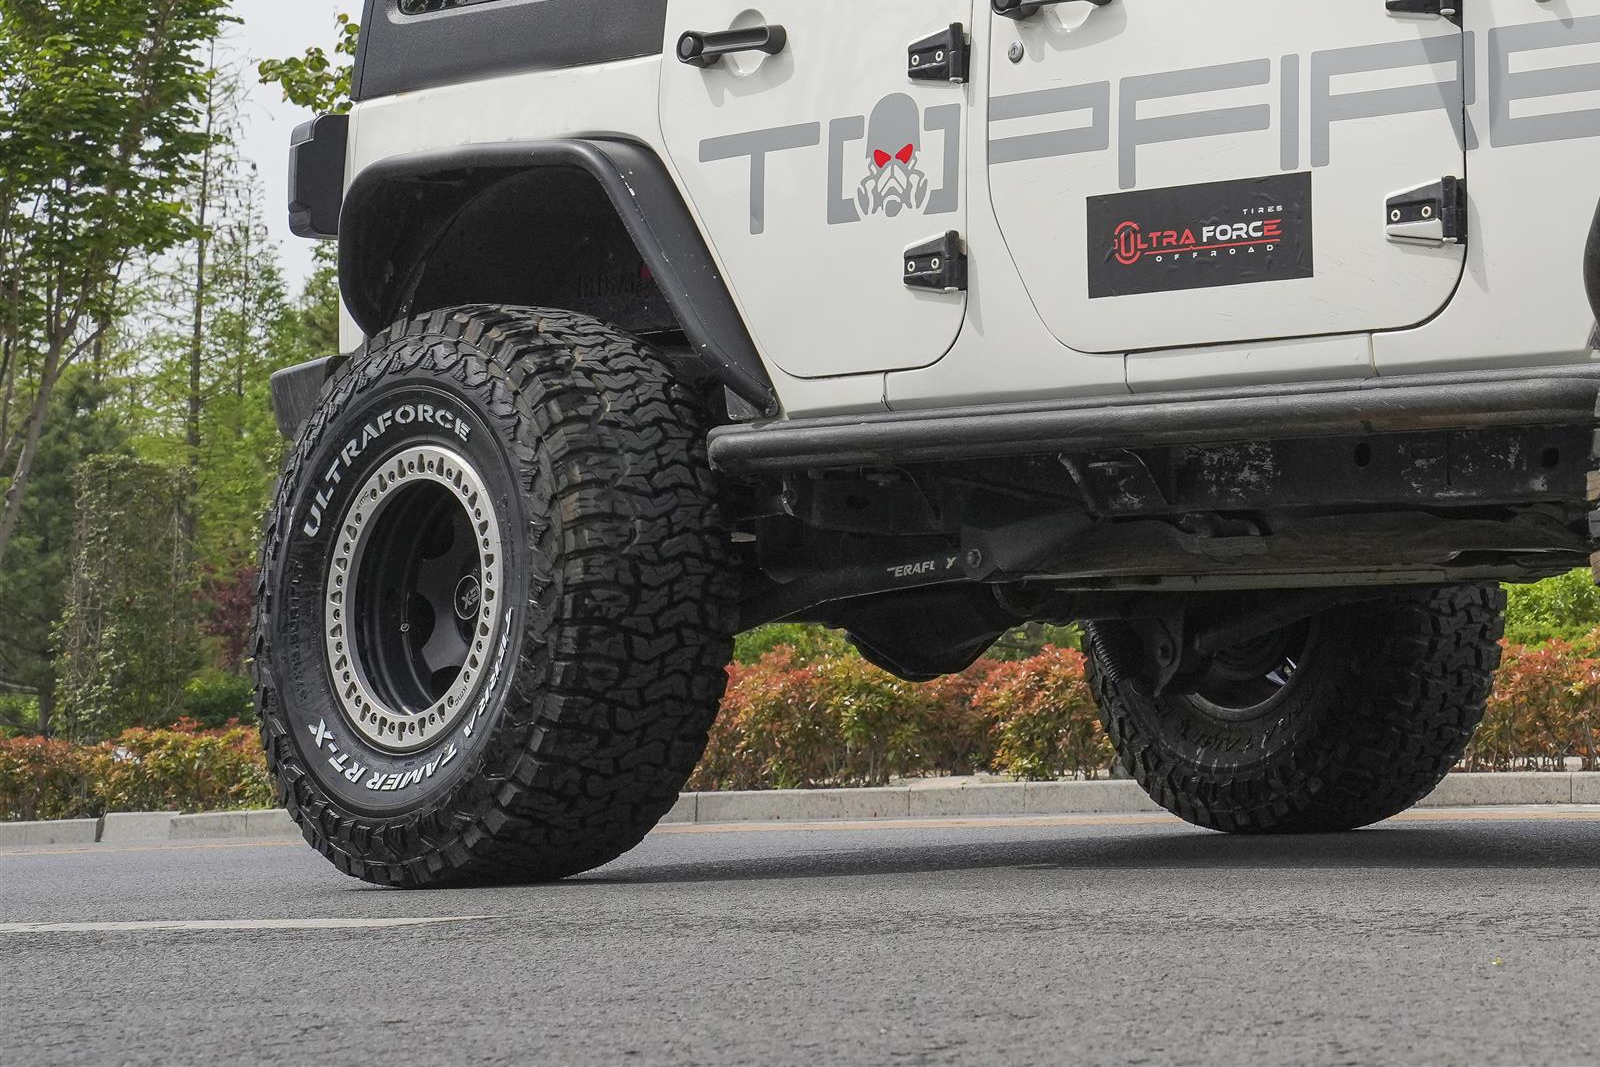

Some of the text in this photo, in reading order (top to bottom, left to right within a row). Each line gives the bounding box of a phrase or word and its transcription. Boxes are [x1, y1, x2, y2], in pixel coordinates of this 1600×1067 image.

[1242, 205, 1283, 215] TIRES
[1114, 219, 1282, 265] ULTRA FORCE
[1156, 245, 1273, 262] OFFROAD
[303, 404, 472, 539] ULTRAFORCE
[308, 718, 368, 784] RT-X
[366, 742, 457, 790] TAMER
